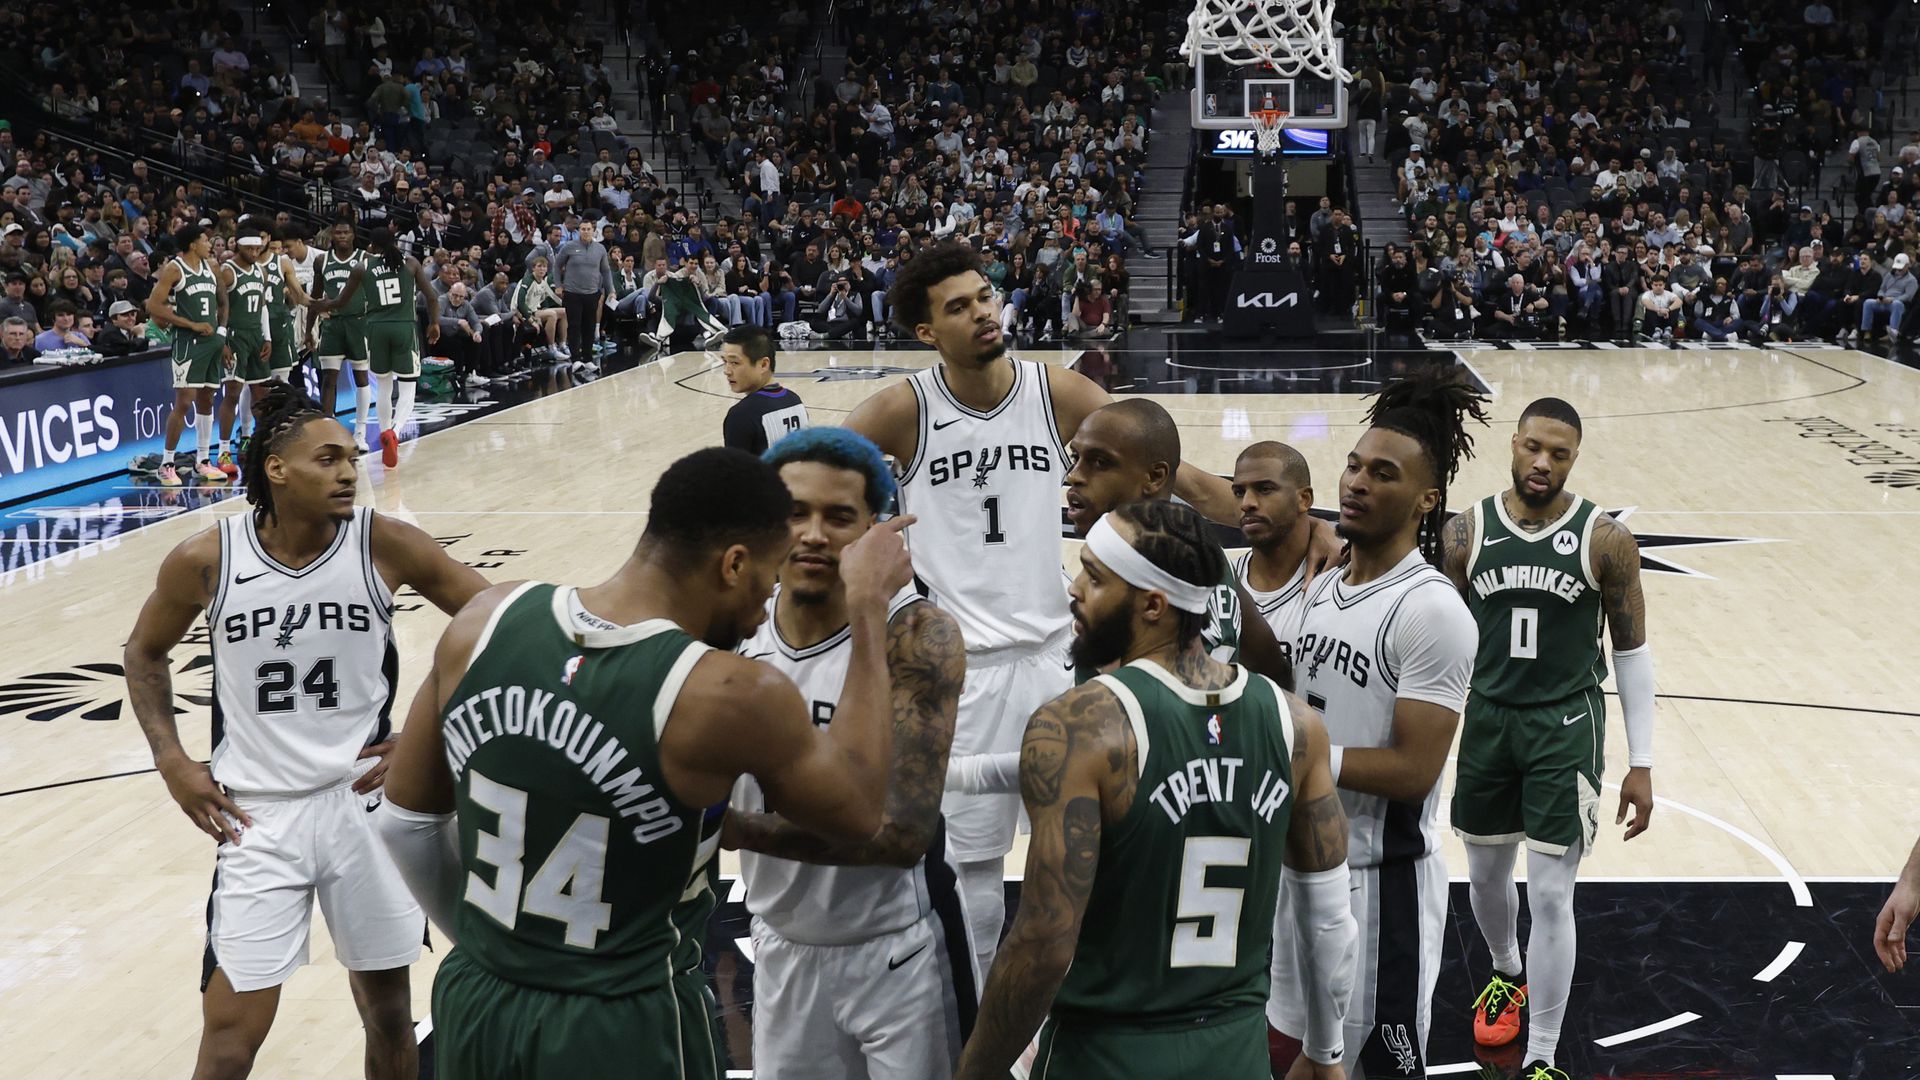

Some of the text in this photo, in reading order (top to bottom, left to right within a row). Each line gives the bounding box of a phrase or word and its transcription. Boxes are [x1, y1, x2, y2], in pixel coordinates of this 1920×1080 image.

[1255, 252, 1281, 263] Frost
[200, 297, 209, 316] 3
[247, 295, 259, 312] 17
[376, 277, 401, 306] 12
[1237, 292, 1298, 308] KIA
[132, 397, 164, 440] for
[929, 446, 1051, 490] SPURS
[981, 494, 1008, 546] 1
[1471, 564, 1586, 604] MILWAUKEE
[224, 601, 371, 649] SPURS
[1510, 607, 1539, 660] 0
[255, 655, 341, 716] 24
[442, 685, 684, 846] ANTETOKOUNMPO
[1149, 756, 1290, 826] TRENT JR
[463, 768, 613, 950] 34
[1169, 835, 1252, 969] 5
